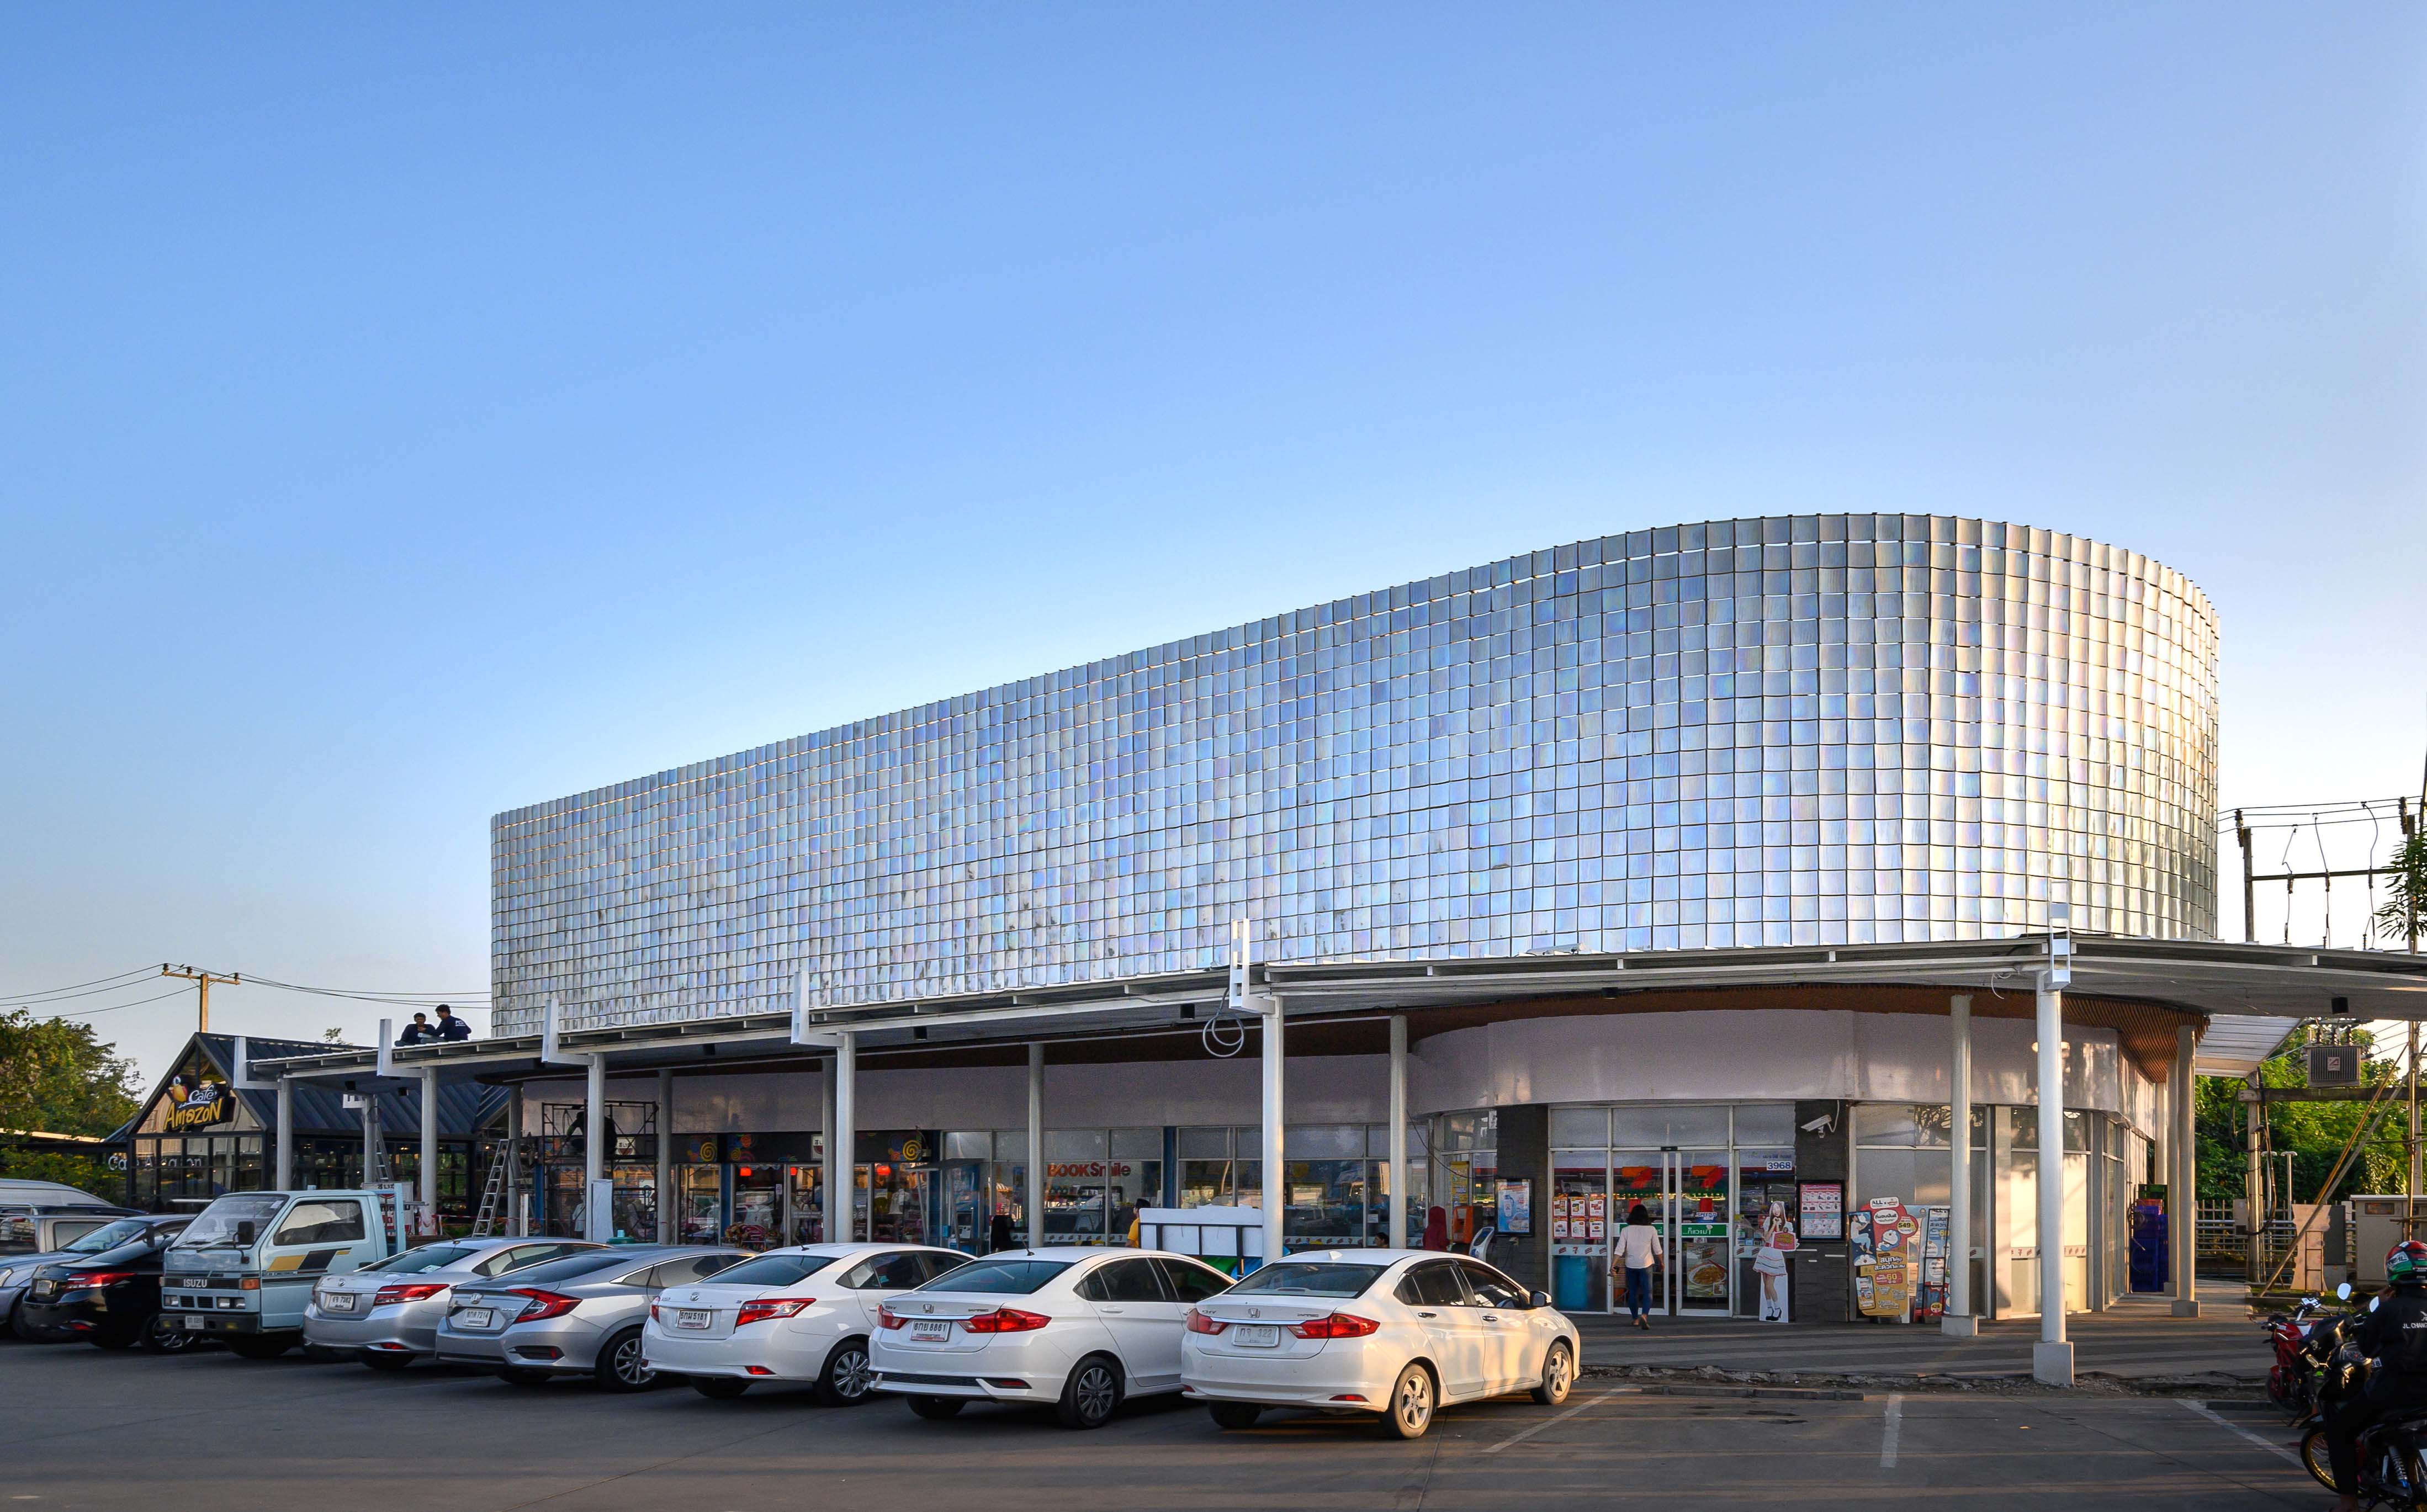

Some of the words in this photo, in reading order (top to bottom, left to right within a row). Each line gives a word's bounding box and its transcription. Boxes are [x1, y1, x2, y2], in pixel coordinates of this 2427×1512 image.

[183, 1279, 207, 1287] ISUZU
[693, 1312, 708, 1320] 5181
[930, 1323, 946, 1332] 8861
